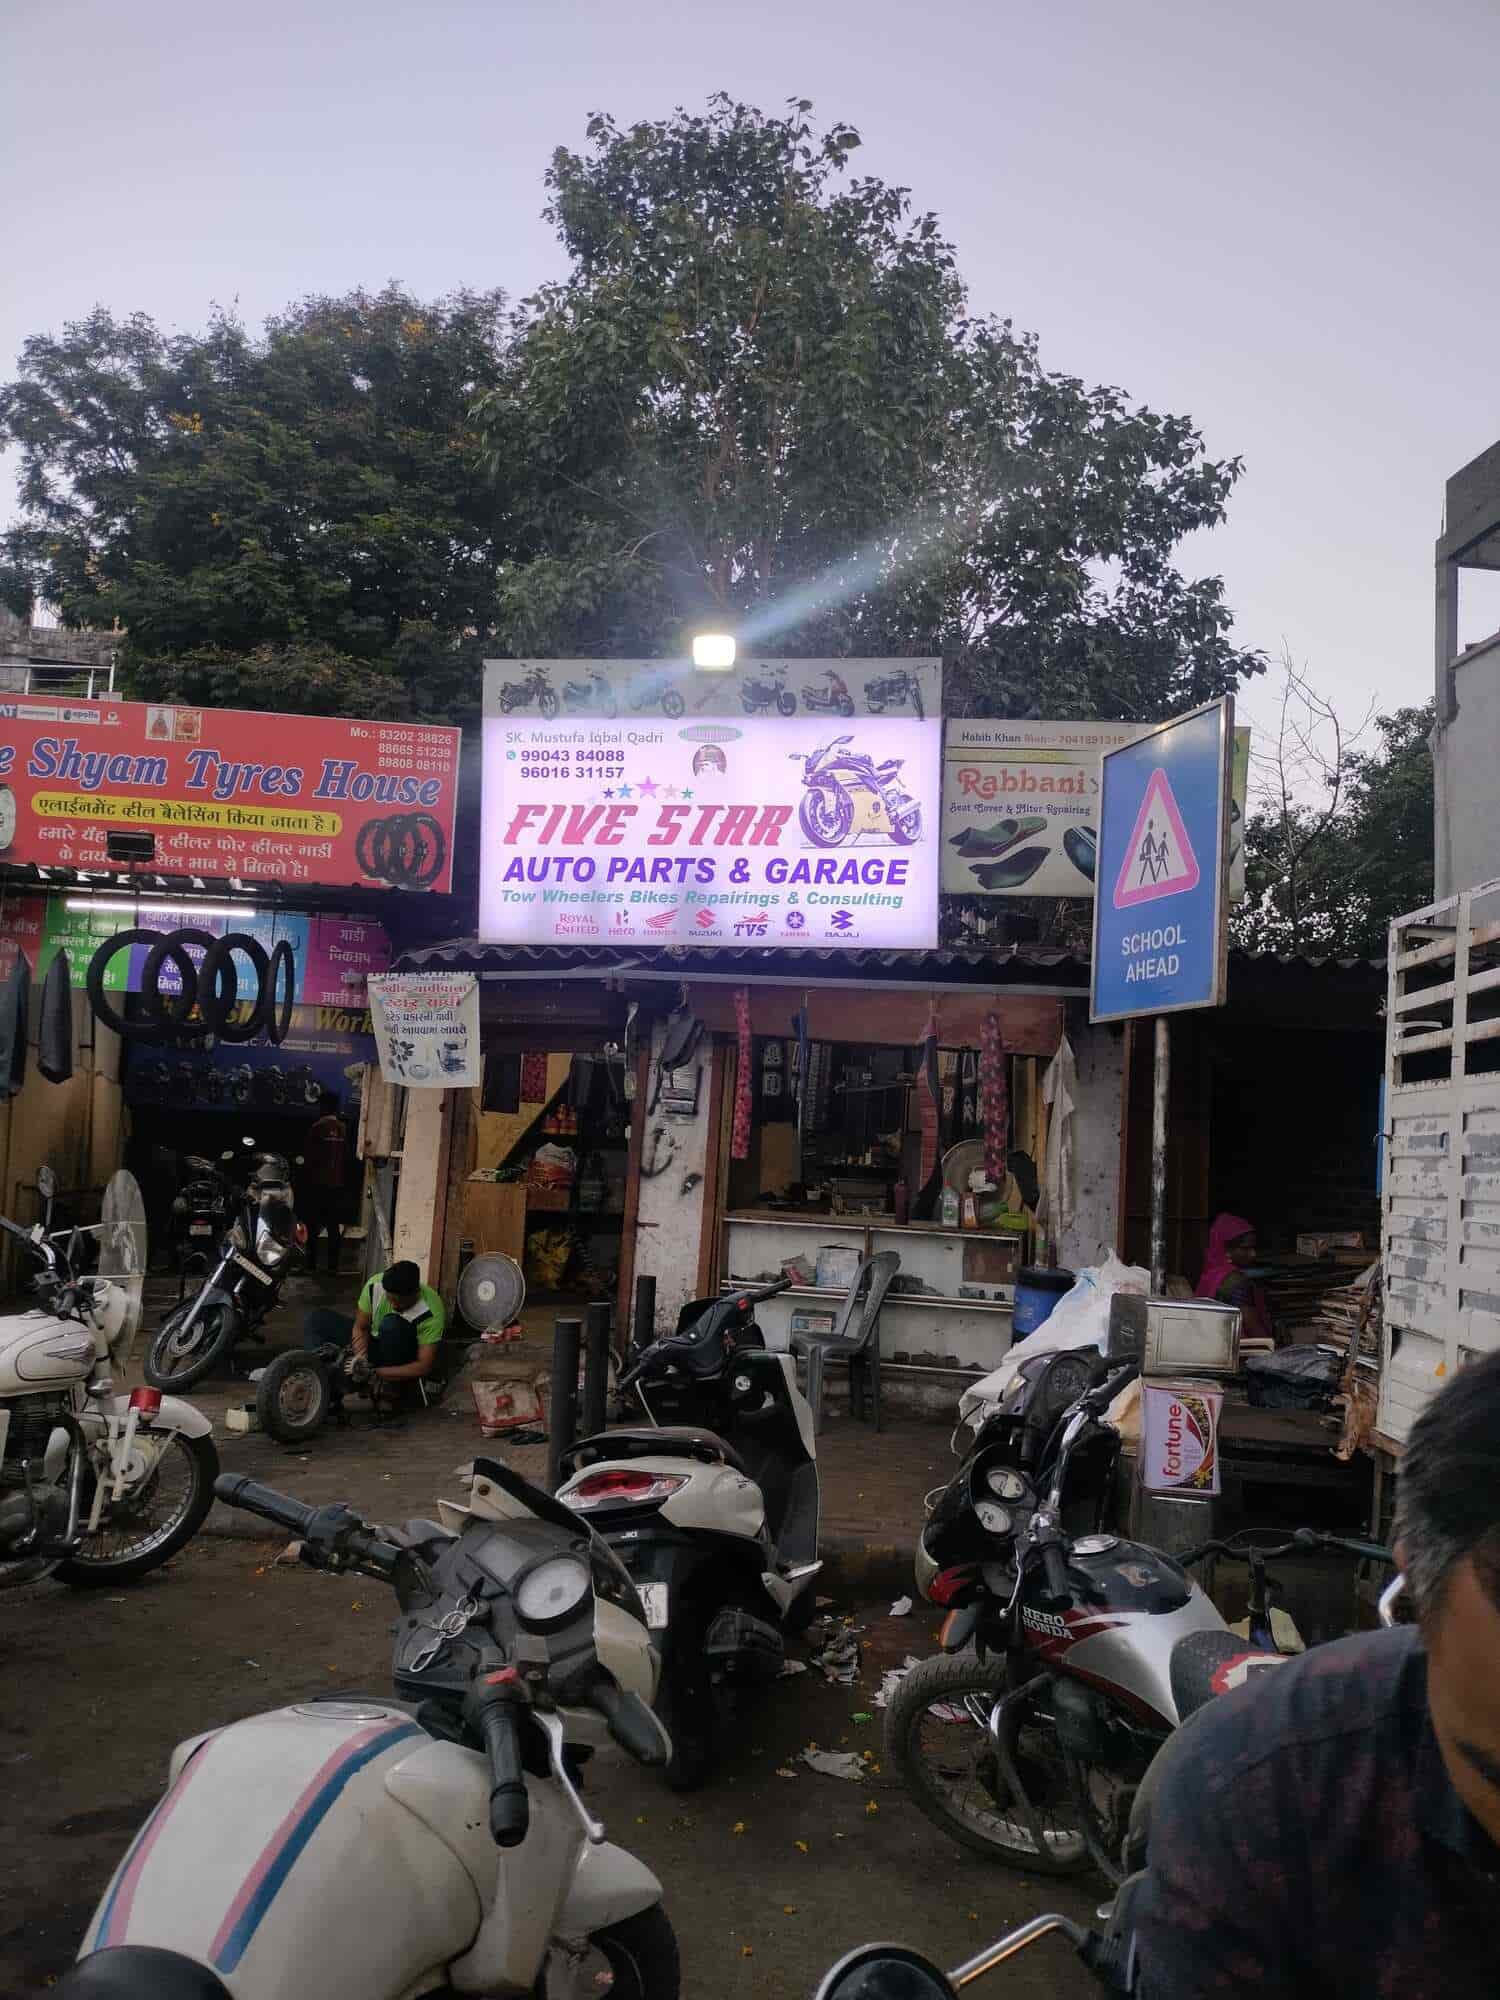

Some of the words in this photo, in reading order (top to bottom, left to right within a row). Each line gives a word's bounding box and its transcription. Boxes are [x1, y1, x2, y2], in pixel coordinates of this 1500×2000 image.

[531, 732, 585, 743] Mustufa
[590, 732, 622, 745] Iqbal
[627, 732, 664, 744] Qadri
[521, 750, 570, 761] 99043
[575, 750, 625, 761] 84088
[28, 737, 168, 790] Shyam
[185, 748, 304, 800] Tyres
[312, 759, 441, 807] House
[520, 767, 570, 778] 96016
[575, 767, 625, 778] 31157
[957, 766, 1087, 800] Rabbani
[227, 808, 264, 826] किया
[271, 815, 308, 830] जाता
[503, 804, 639, 845] FIVE
[647, 804, 794, 846] STAR
[38, 824, 77, 840] हमारे
[58, 844, 73, 861] के
[188, 857, 218, 871] भाव
[224, 856, 238, 873] से
[243, 857, 287, 877] मिलते
[502, 857, 597, 882] AUTO
[606, 857, 716, 883] PARTS
[729, 858, 750, 883] &
[765, 858, 909, 885] GARAGE
[501, 890, 536, 903] Tow
[543, 890, 624, 903] Wheelers
[630, 890, 679, 904] Bikes
[685, 892, 780, 908] Repairings
[787, 892, 799, 904] &
[807, 892, 904, 909] Consulting
[559, 912, 594, 923] ROYAL
[733, 924, 768, 937] TVS
[1121, 924, 1187, 956] SCHOOL
[1125, 955, 1180, 983] AHEAD
[1162, 1403, 1182, 1477] fortune
[1022, 1616, 1074, 1640] HONDA
[1023, 1606, 1065, 1628] HERO
